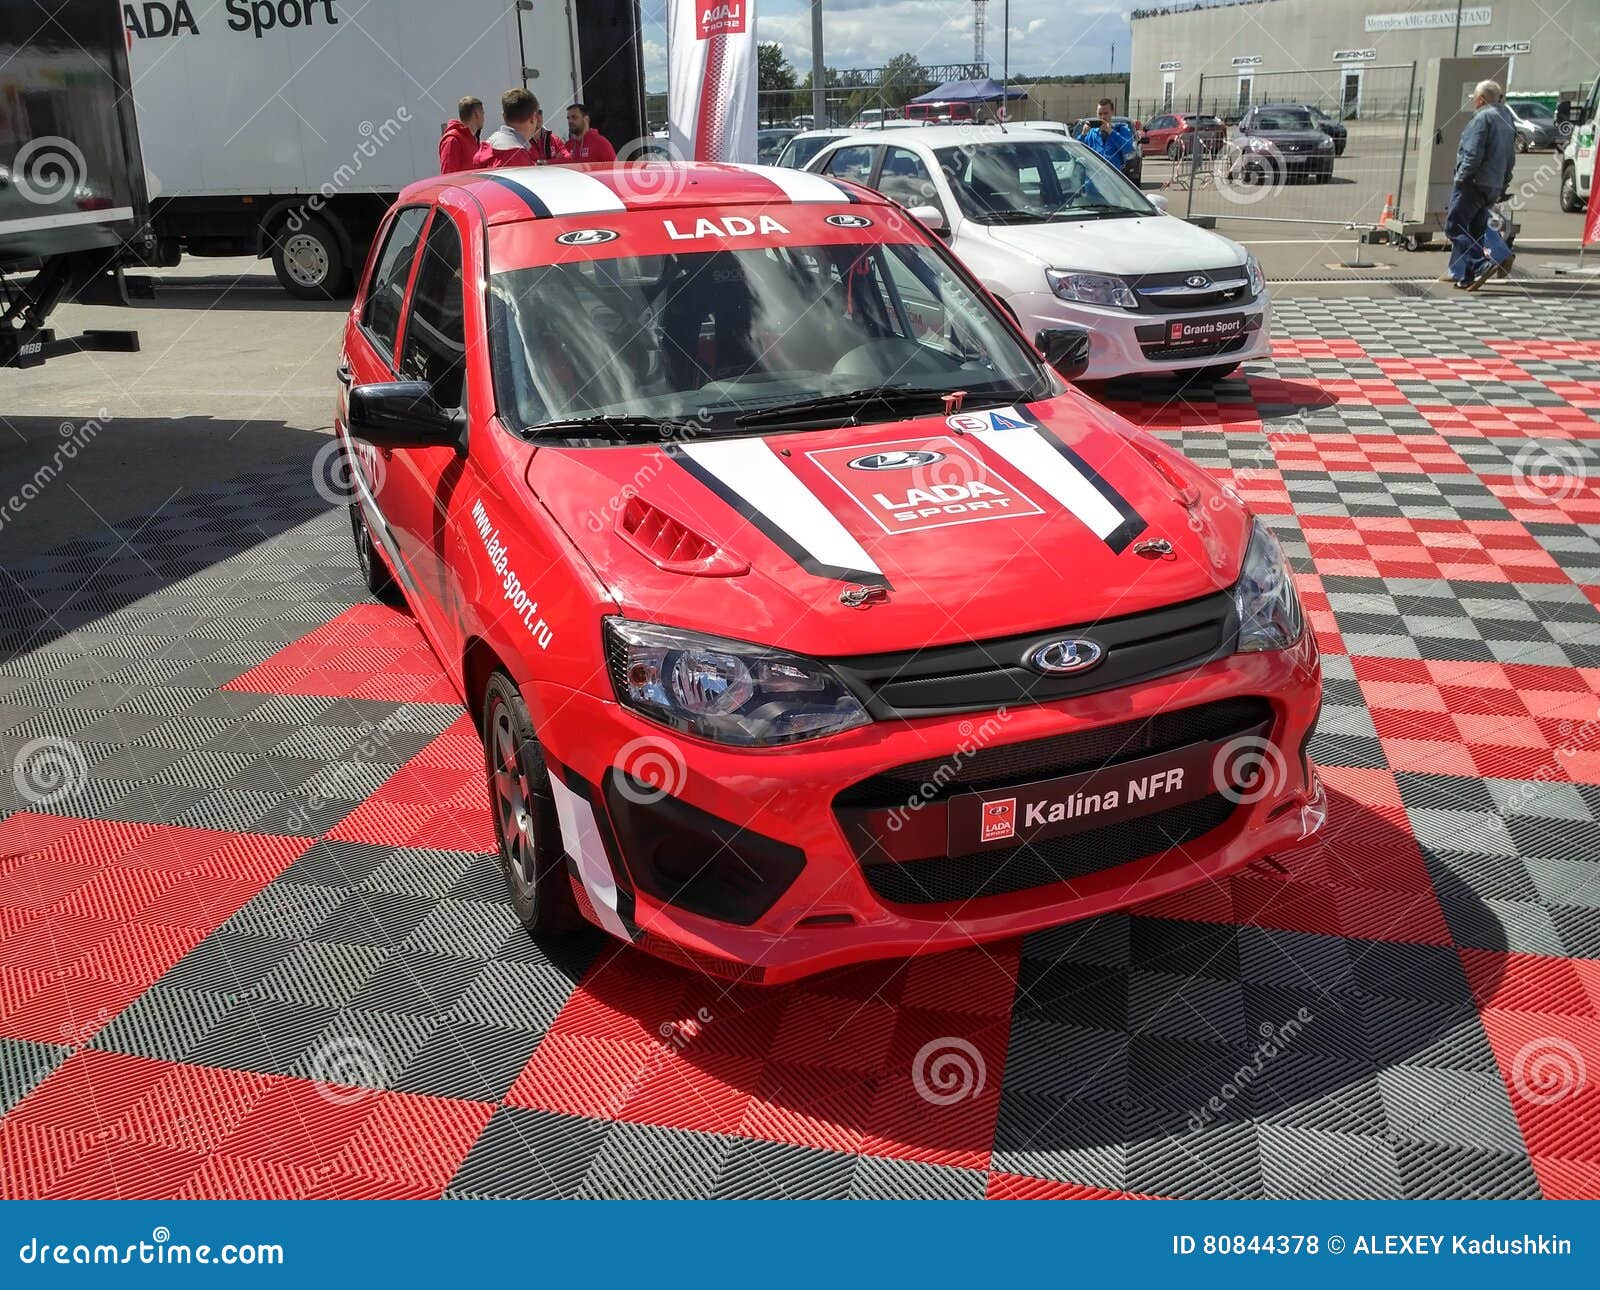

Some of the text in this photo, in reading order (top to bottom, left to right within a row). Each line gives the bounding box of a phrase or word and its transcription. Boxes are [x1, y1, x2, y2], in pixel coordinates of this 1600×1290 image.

[123, 0, 338, 38] ADA Sport
[1425, 10, 1490, 24] GRANDSTAND
[663, 215, 790, 240] LADA
[1183, 319, 1240, 335] Granta Sport
[20, 342, 42, 356] MBB
[871, 480, 1004, 510] LADA
[894, 498, 1012, 522] SPORT
[471, 498, 554, 650] www.lada-sport.ru
[1024, 767, 1185, 827] Kalina NFR
[985, 828, 1011, 838] SPORT
[986, 821, 1012, 833] LADA
